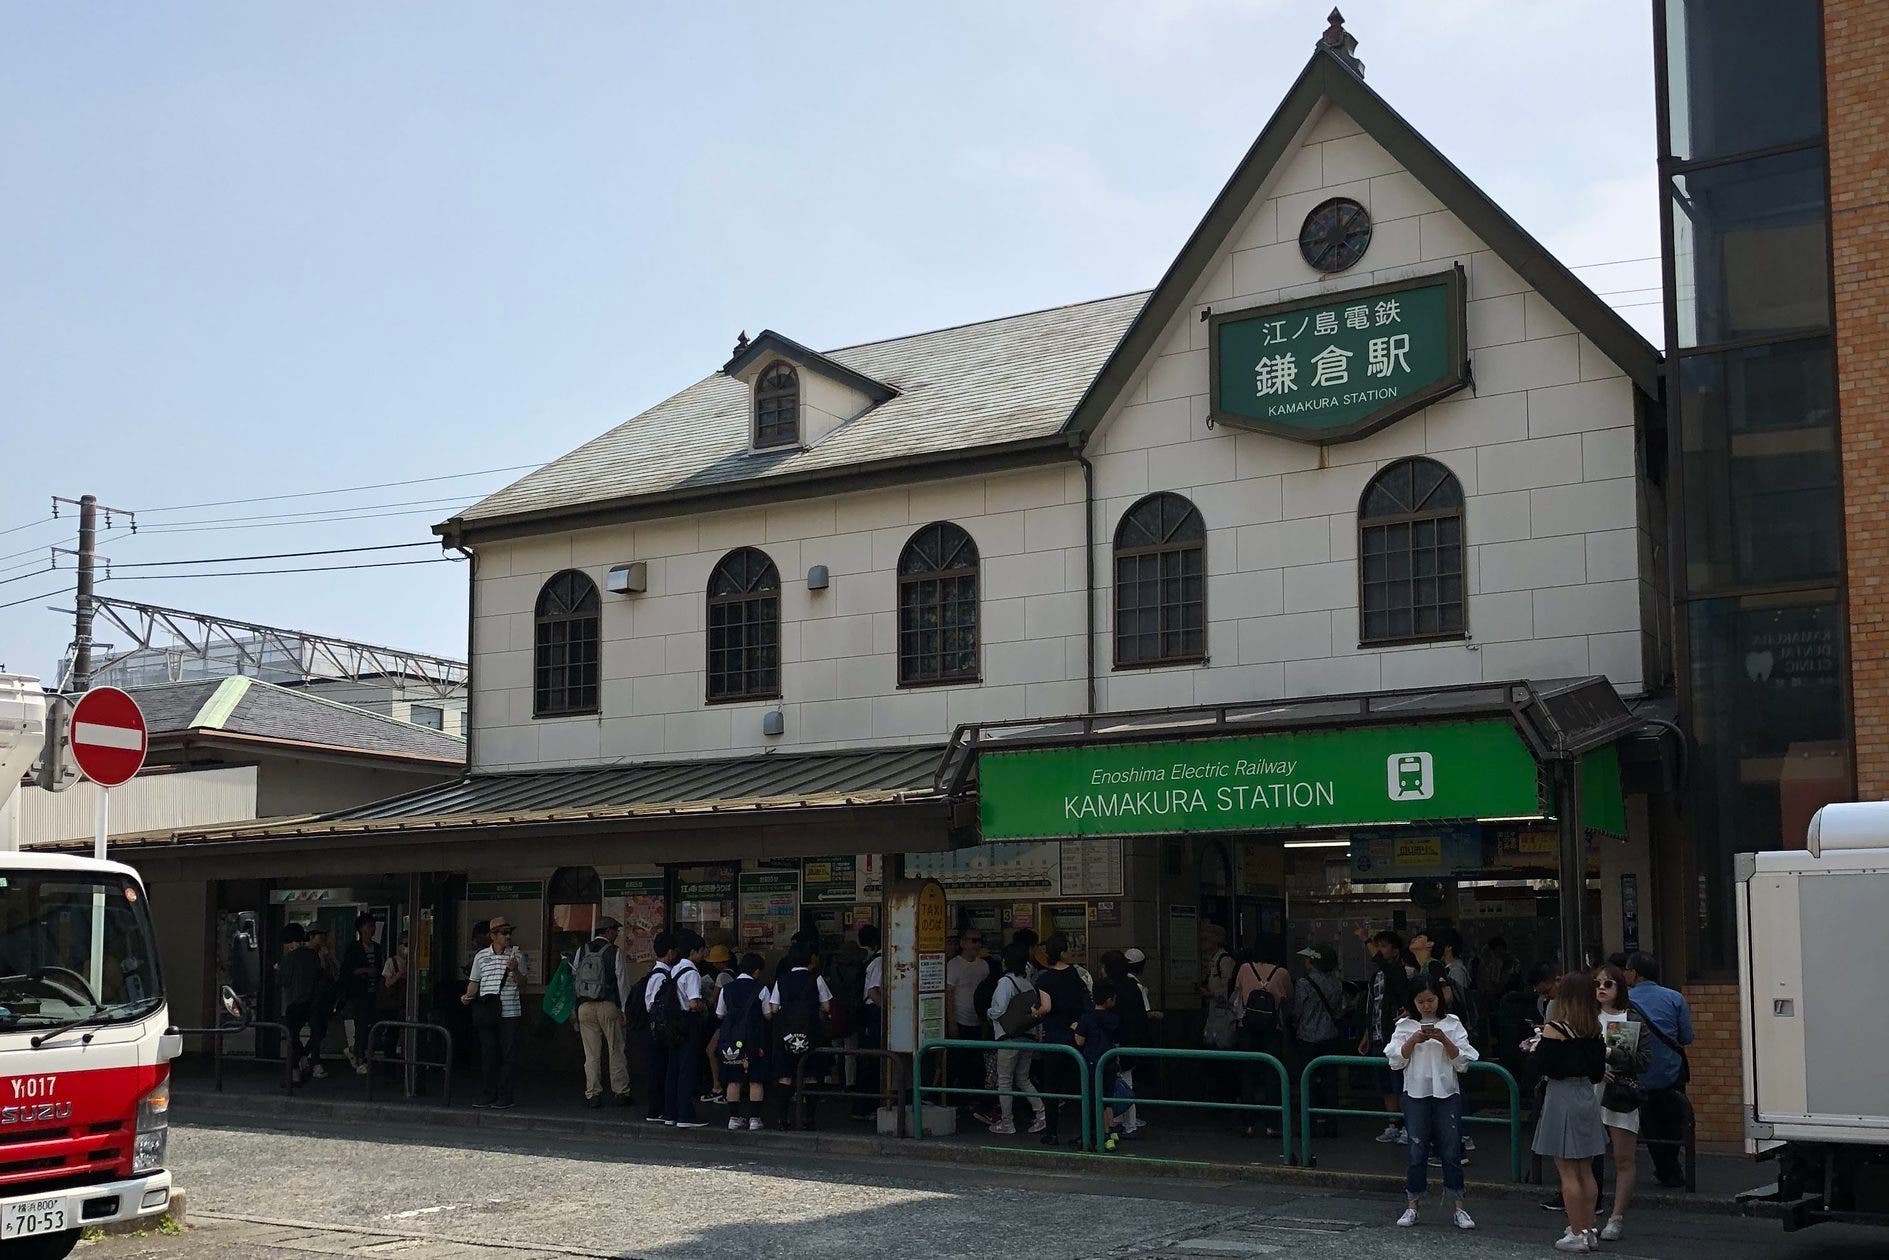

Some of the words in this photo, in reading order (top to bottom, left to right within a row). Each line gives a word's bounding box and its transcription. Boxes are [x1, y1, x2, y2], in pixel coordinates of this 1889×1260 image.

[1262, 299, 1401, 347] 江ノ島電鉄
[1254, 333, 1411, 397] 鎌倉駅
[1268, 396, 1339, 417] KAMAKURA
[1343, 386, 1397, 405] STATION
[1091, 767, 1167, 785] Enoshima
[1170, 762, 1230, 780] Electric
[1234, 758, 1297, 777] Railway
[1064, 787, 1207, 819] KAMAKURA
[1216, 780, 1335, 812] STATION
[921, 904, 944, 918] TAXI
[0, 1101, 72, 1125] SUZU
[16, 1210, 64, 1235] 70-53
